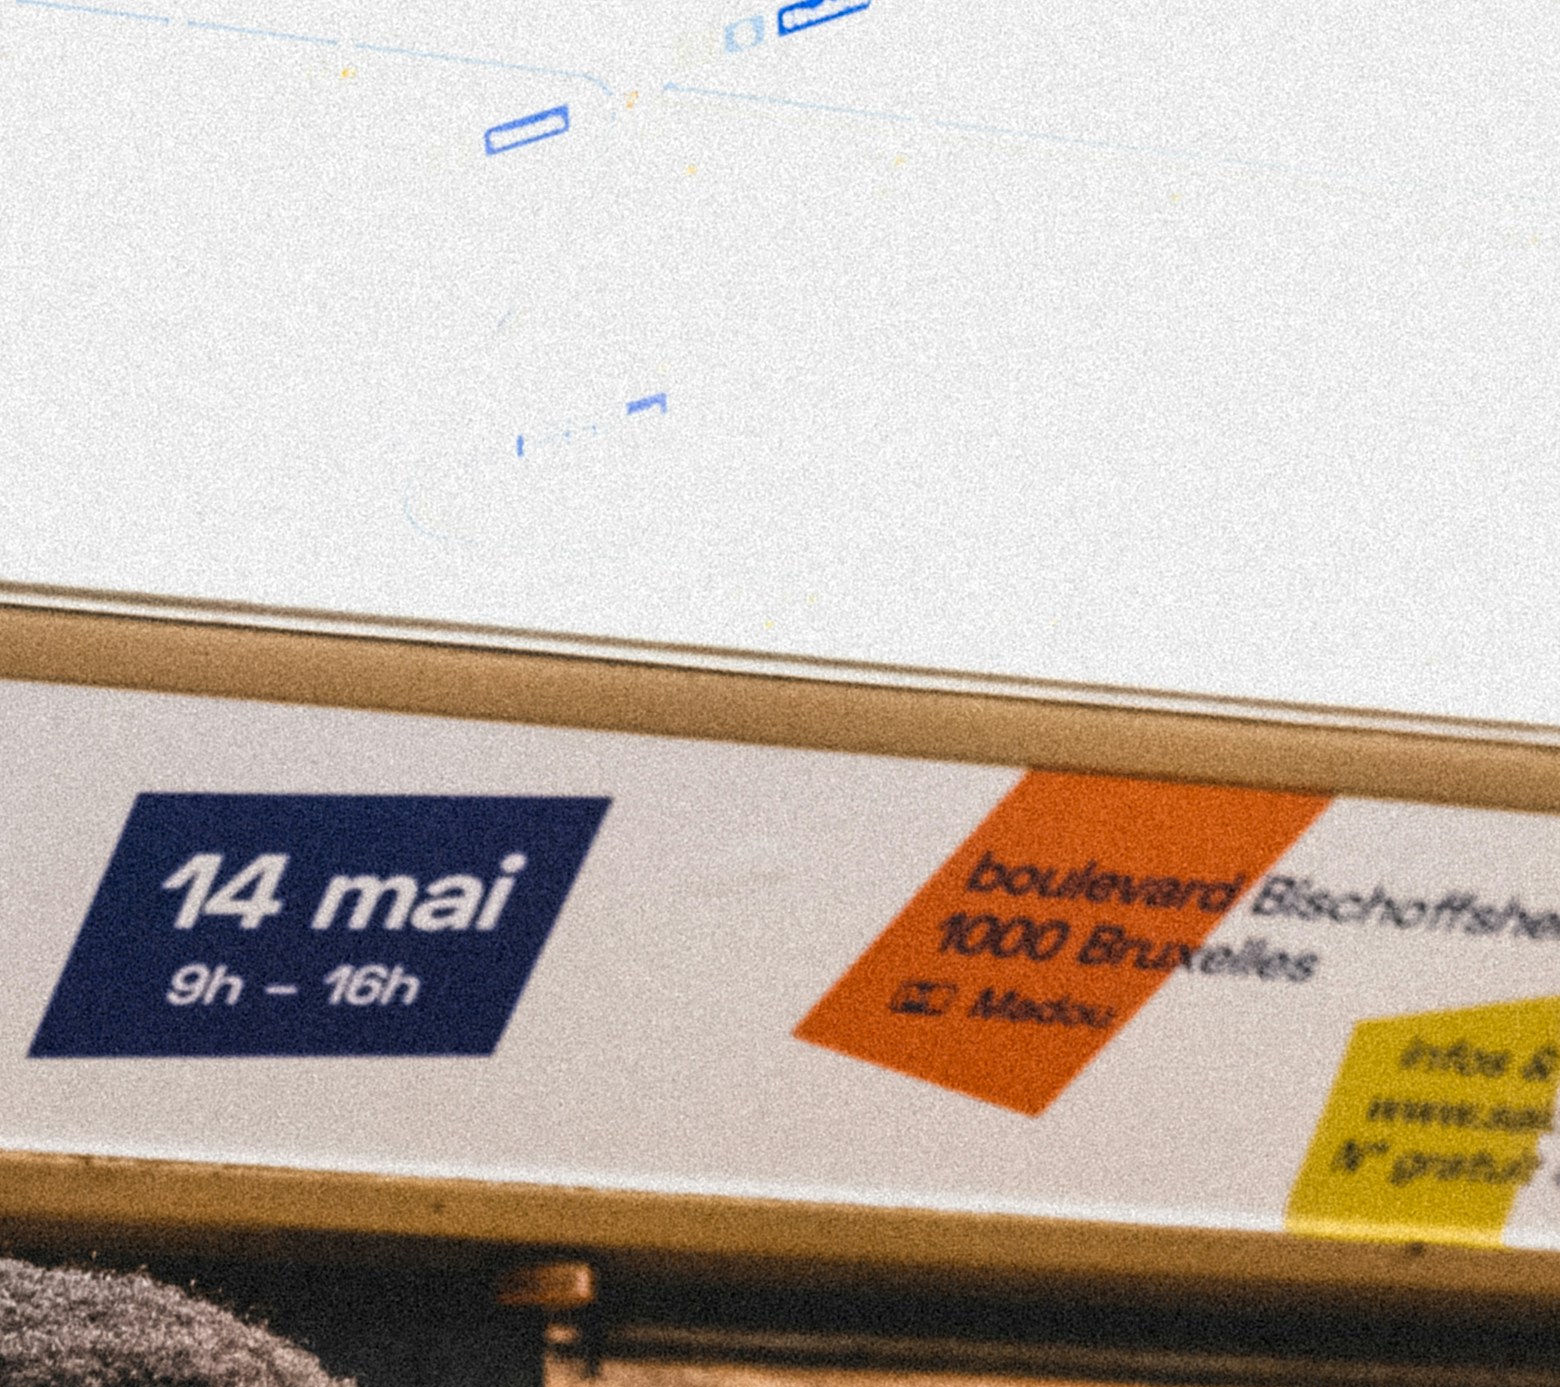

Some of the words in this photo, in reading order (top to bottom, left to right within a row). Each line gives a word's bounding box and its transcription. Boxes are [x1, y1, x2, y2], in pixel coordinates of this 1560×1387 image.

[161, 852, 290, 931] 14
[311, 852, 527, 932] mai
[965, 851, 1248, 914] boulevard
[937, 911, 1071, 963] 1000
[1075, 923, 1318, 984] Bruxelles
[166, 962, 244, 1007] 9h
[323, 963, 420, 1007] 16h
